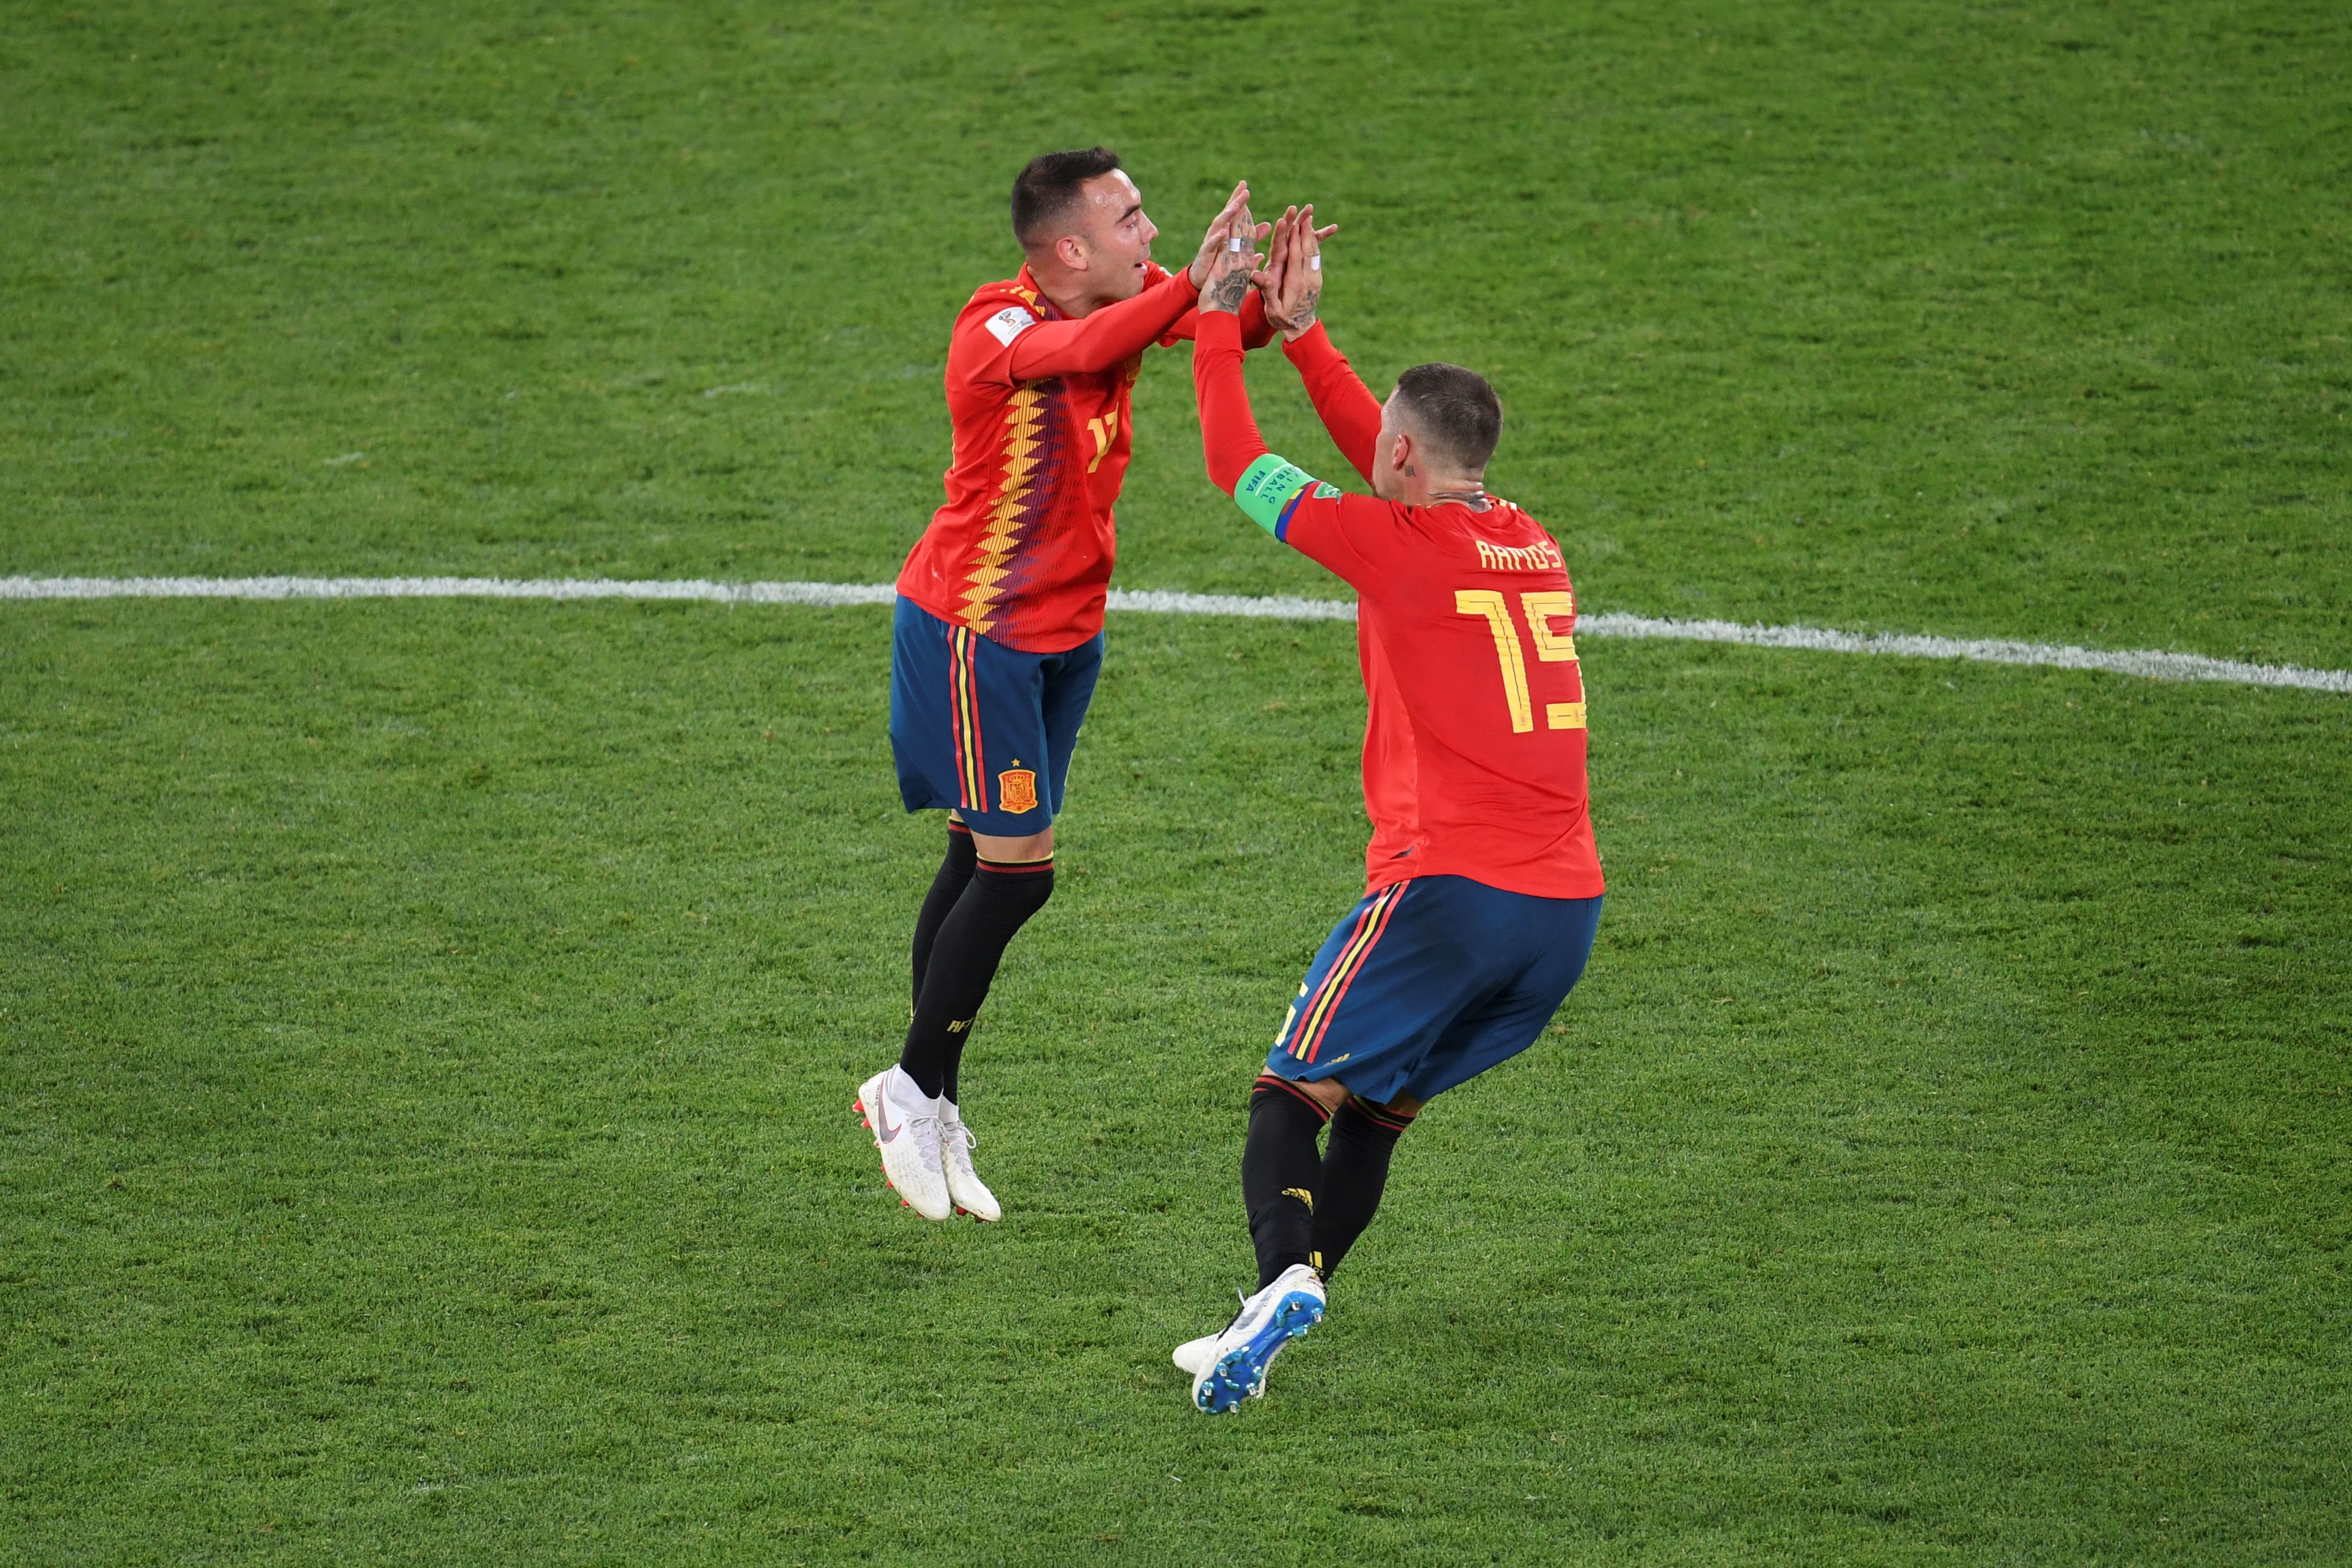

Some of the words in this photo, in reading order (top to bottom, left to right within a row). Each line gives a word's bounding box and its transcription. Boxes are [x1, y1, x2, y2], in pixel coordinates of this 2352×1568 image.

[1086, 401, 1119, 474] 17
[1246, 470, 1266, 492] FIFA
[1475, 540, 1563, 571] RAMOS
[1454, 590, 1587, 733] 15
